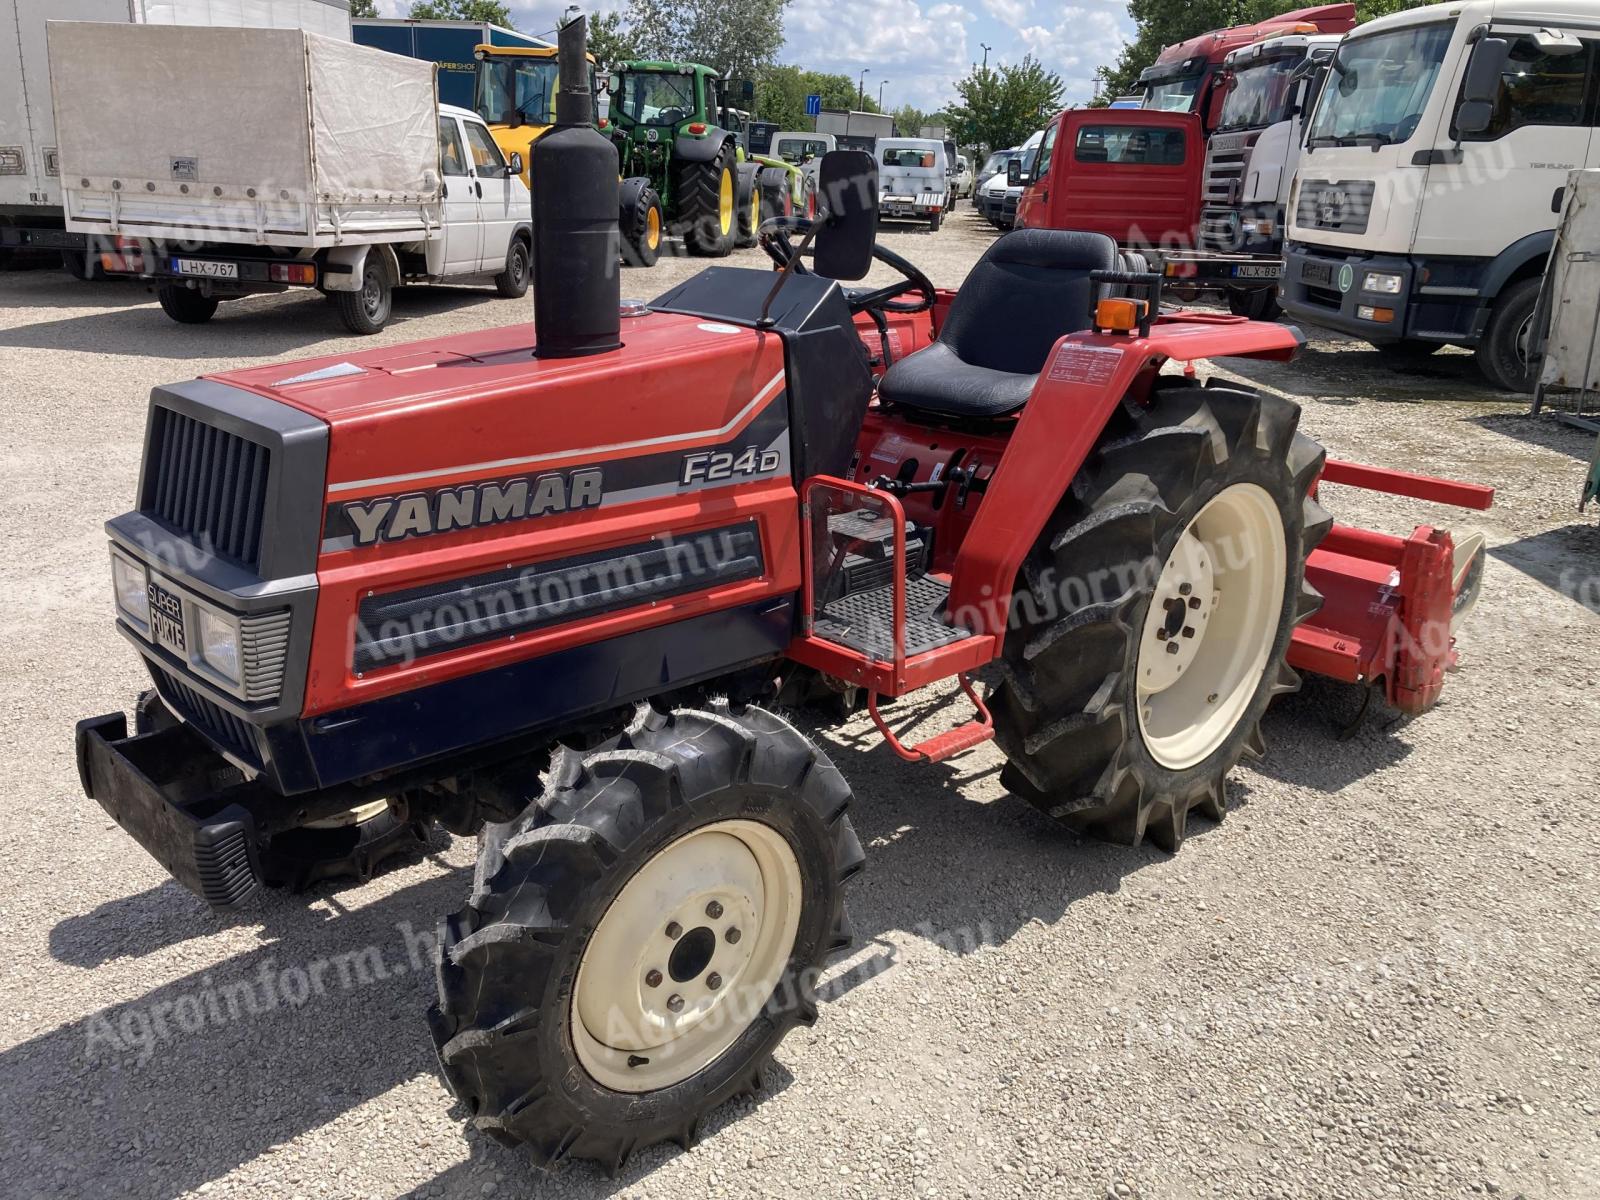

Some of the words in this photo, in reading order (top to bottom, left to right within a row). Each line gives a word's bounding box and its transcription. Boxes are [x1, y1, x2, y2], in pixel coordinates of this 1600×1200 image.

[649, 131, 656, 140] 50
[181, 260, 234, 276] LHX-767
[682, 446, 781, 485] F24D
[345, 468, 603, 545] YANMAR
[148, 584, 181, 620] SUPER
[150, 606, 186, 651] FORTE
